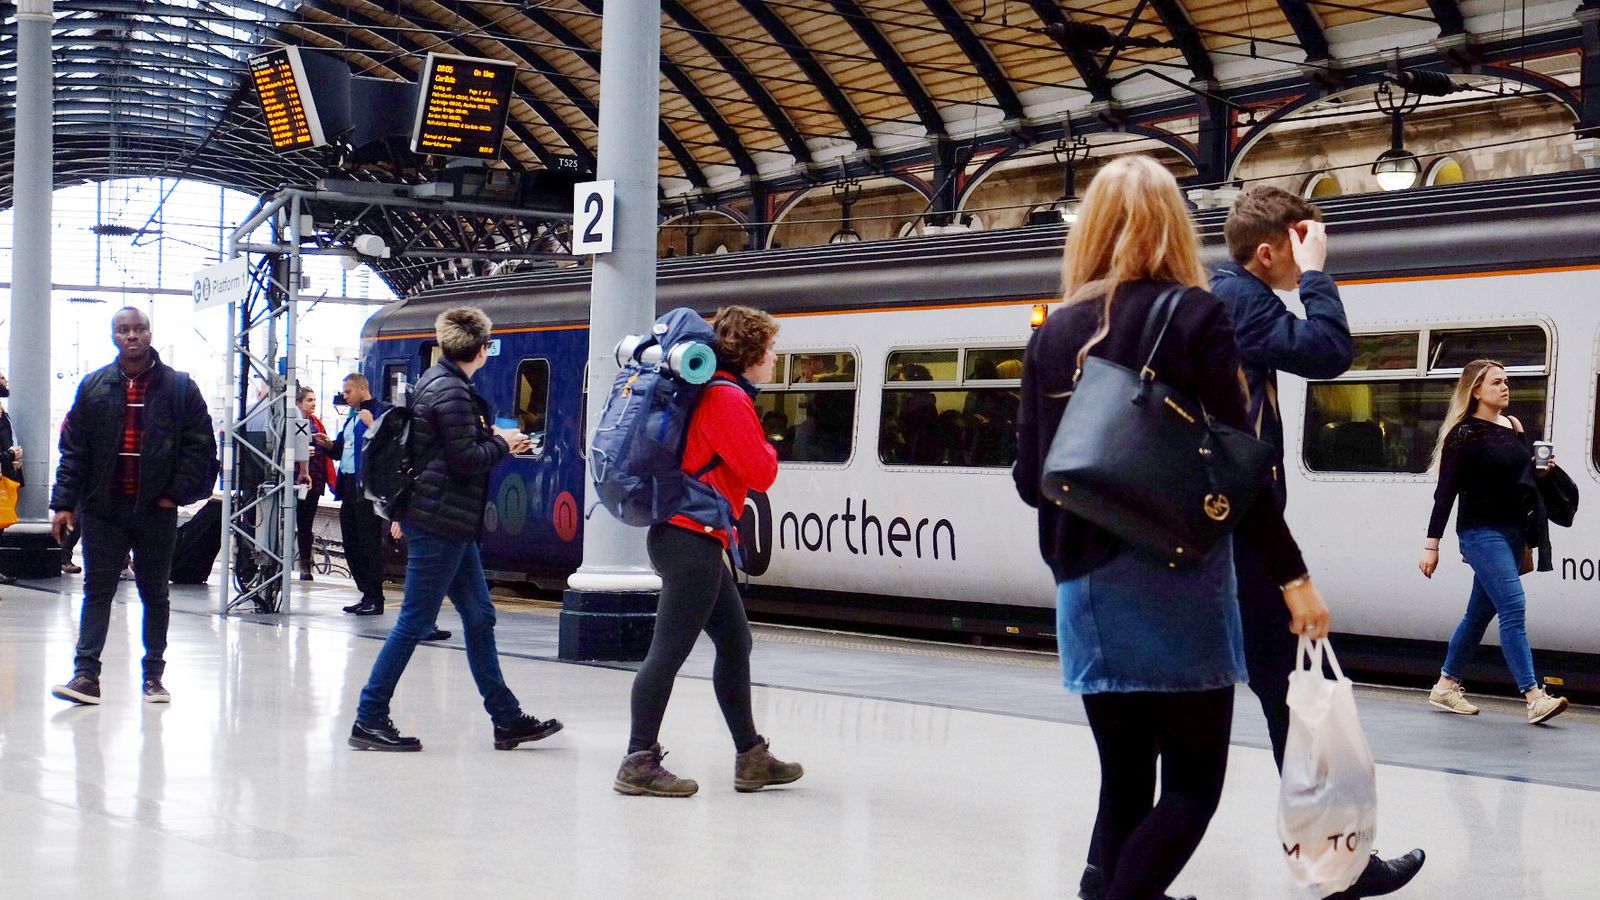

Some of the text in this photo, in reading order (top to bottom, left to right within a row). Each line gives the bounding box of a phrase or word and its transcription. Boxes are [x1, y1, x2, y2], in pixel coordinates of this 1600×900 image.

[559, 158, 578, 168] T525
[582, 191, 604, 243] 2
[212, 276, 240, 295] Platform
[779, 496, 957, 561] northern
[1562, 557, 1600, 581] no
